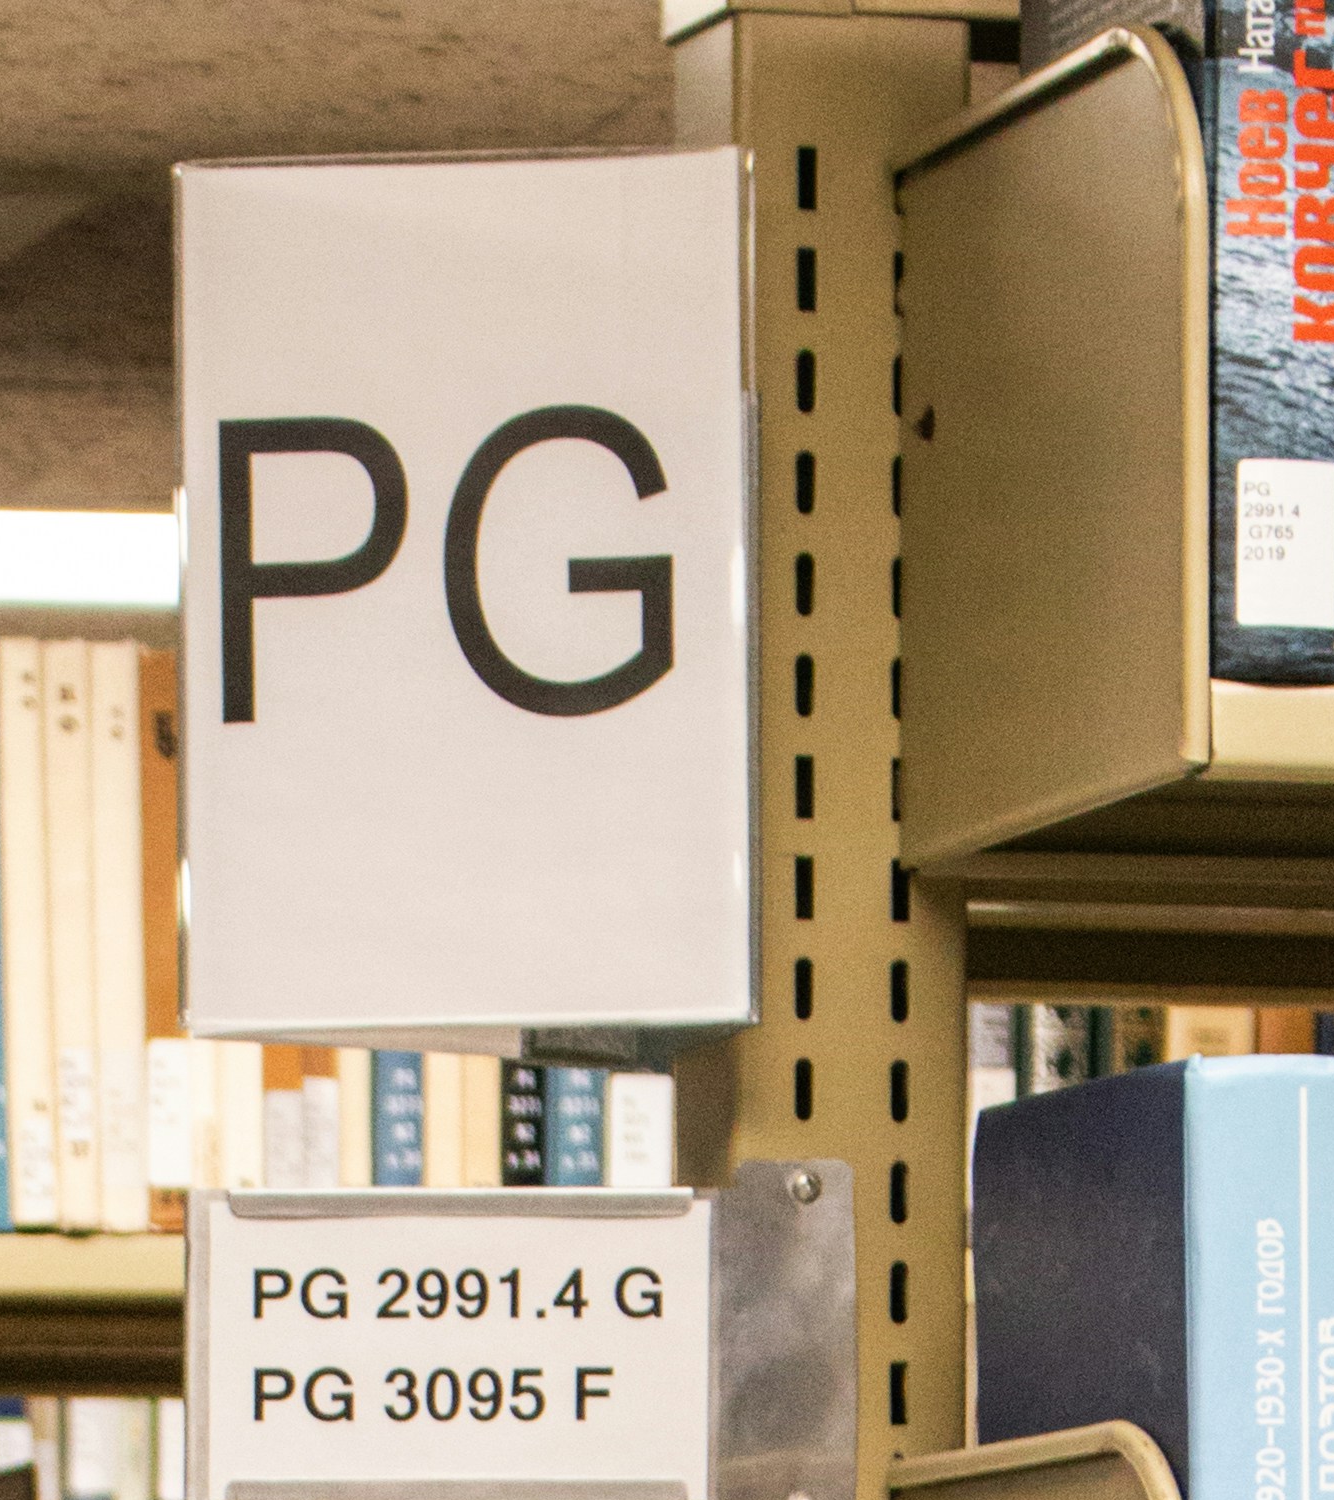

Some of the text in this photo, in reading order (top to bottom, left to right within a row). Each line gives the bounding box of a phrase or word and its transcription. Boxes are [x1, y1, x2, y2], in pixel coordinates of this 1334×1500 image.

[1225, 89, 1289, 238] Ноев
[217, 405, 676, 724] PG
[252, 1266, 665, 1320] PG 2991.4 G
[1256, 1218, 1287, 1315] ГОДОВ
[252, 1368, 616, 1423] PG 3095 F
